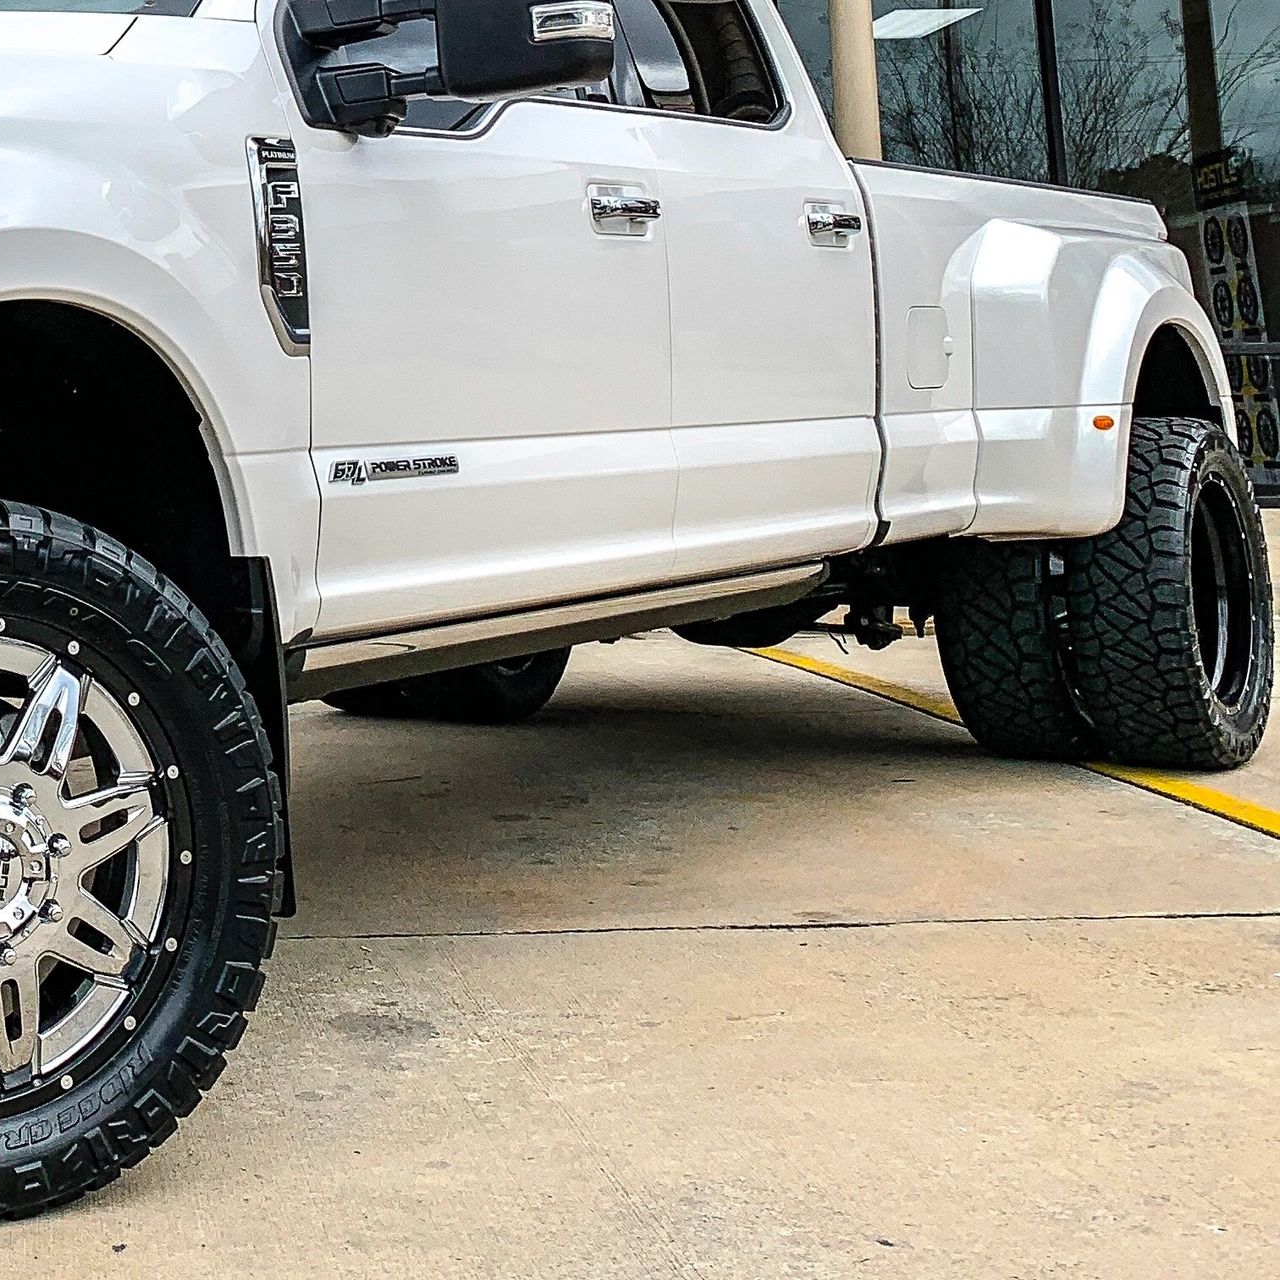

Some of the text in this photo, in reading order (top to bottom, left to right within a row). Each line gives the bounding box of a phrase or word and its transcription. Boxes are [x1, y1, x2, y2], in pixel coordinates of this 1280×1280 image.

[261, 150, 295, 159] PLATINUM
[371, 460, 411, 473] POWER
[412, 456, 457, 470] STROKE
[58, 1039, 154, 1134] RIDGE
